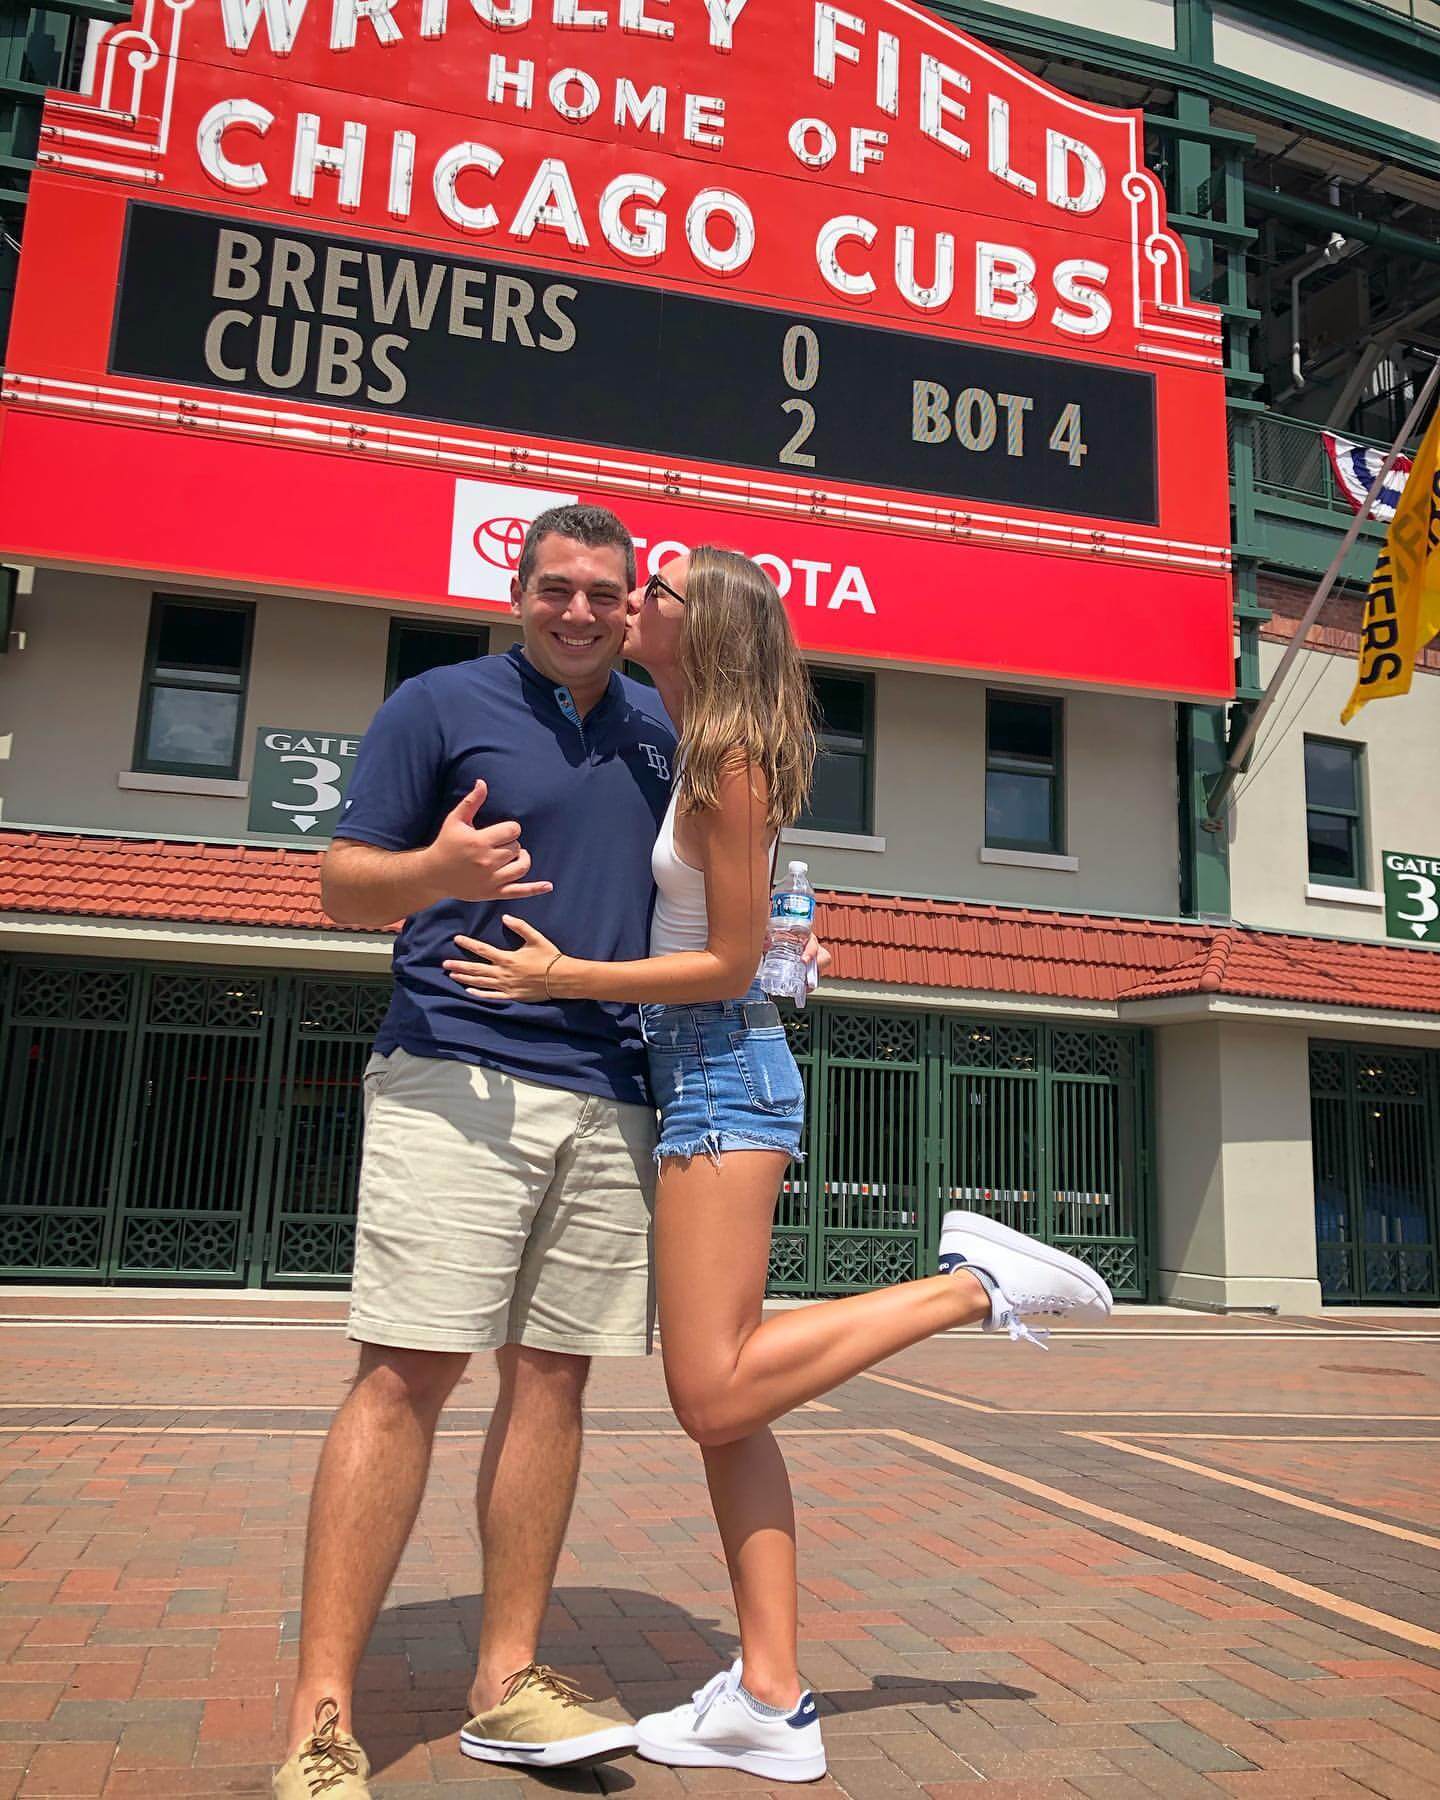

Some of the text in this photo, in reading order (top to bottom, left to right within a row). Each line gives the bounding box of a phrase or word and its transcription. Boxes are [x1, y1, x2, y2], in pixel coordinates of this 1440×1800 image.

[488, 54, 889, 174] HOME OF
[814, 2, 1106, 213] FIELD
[197, 99, 1112, 335] CHICAGO CUBS
[212, 229, 820, 391] BREWERS 0
[204, 310, 817, 467] CUBS 2
[912, 380, 1088, 466] BOT 4
[632, 537, 877, 614] OOTA
[264, 734, 361, 757] GATE
[272, 755, 341, 812] 3
[638, 743, 671, 780] TB
[1386, 855, 1440, 877] GATE
[1397, 873, 1440, 922] 3
